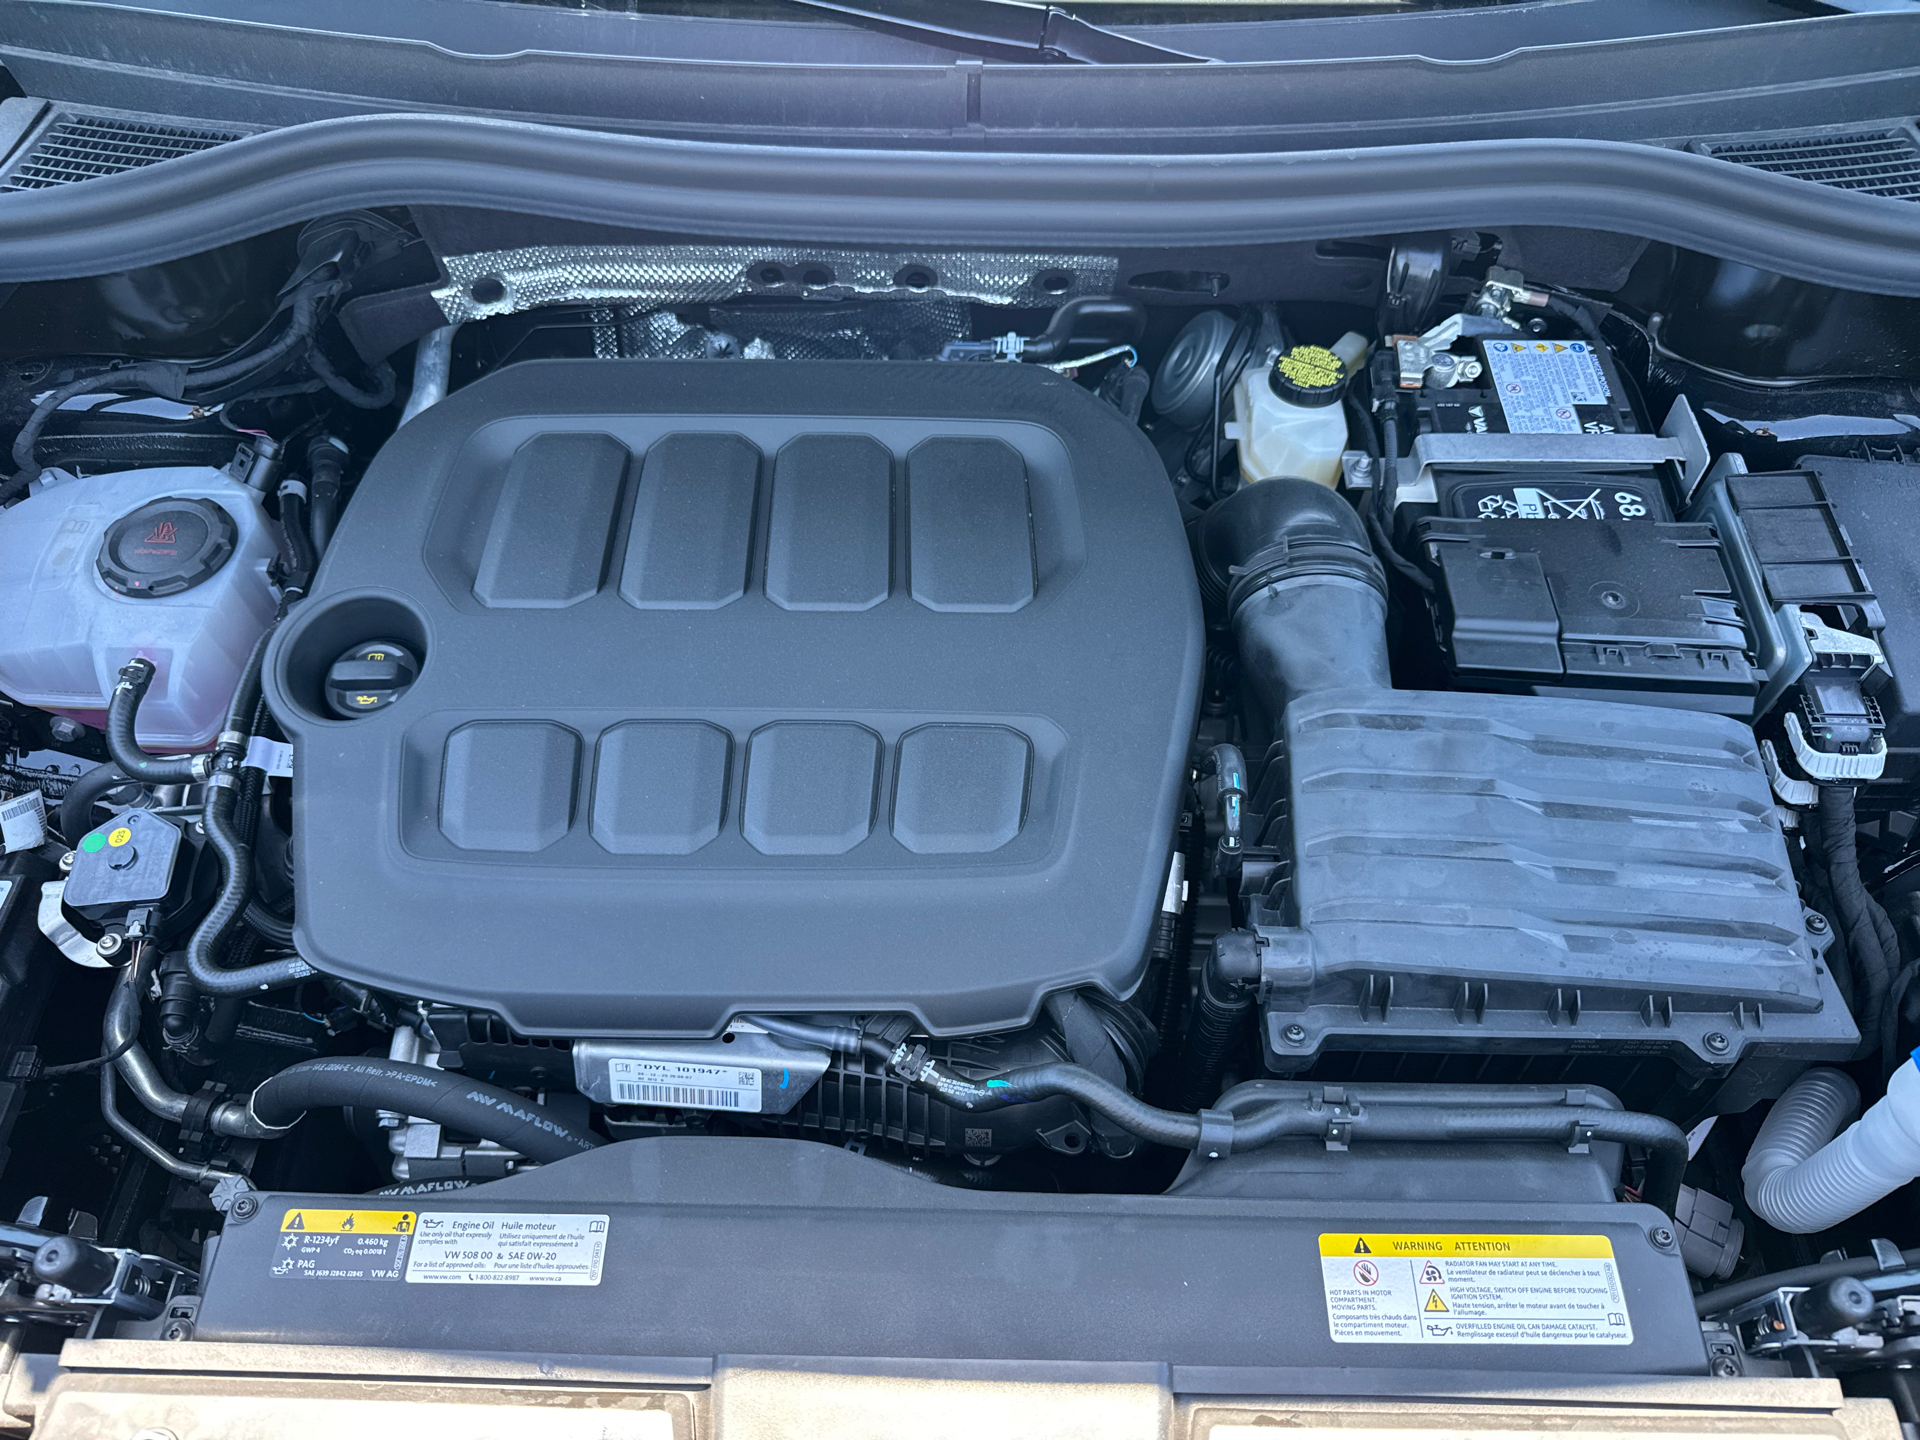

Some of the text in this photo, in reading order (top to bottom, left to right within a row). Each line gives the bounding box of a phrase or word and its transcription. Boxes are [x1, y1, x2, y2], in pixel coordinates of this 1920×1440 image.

[1474, 417, 1488, 434] VA
[1615, 491, 1646, 521] 68
[452, 1221, 495, 1231] Engine Oil
[501, 1222, 557, 1230] Huile moteur
[431, 1231, 444, 1239] only
[521, 1233, 558, 1241] uniquement
[303, 1235, 340, 1246] R-1234yf
[379, 1238, 389, 1247] kg
[1392, 1241, 1511, 1252] WARNING ATTENTION
[444, 1251, 461, 1259] VW
[462, 1251, 479, 1259] 508
[508, 1252, 525, 1260] SAE
[526, 1252, 557, 1260] 0W-20
[297, 1260, 316, 1268] PAG
[371, 1269, 399, 1278] VW AG
[1457, 1331, 1494, 1339] Remplissage
